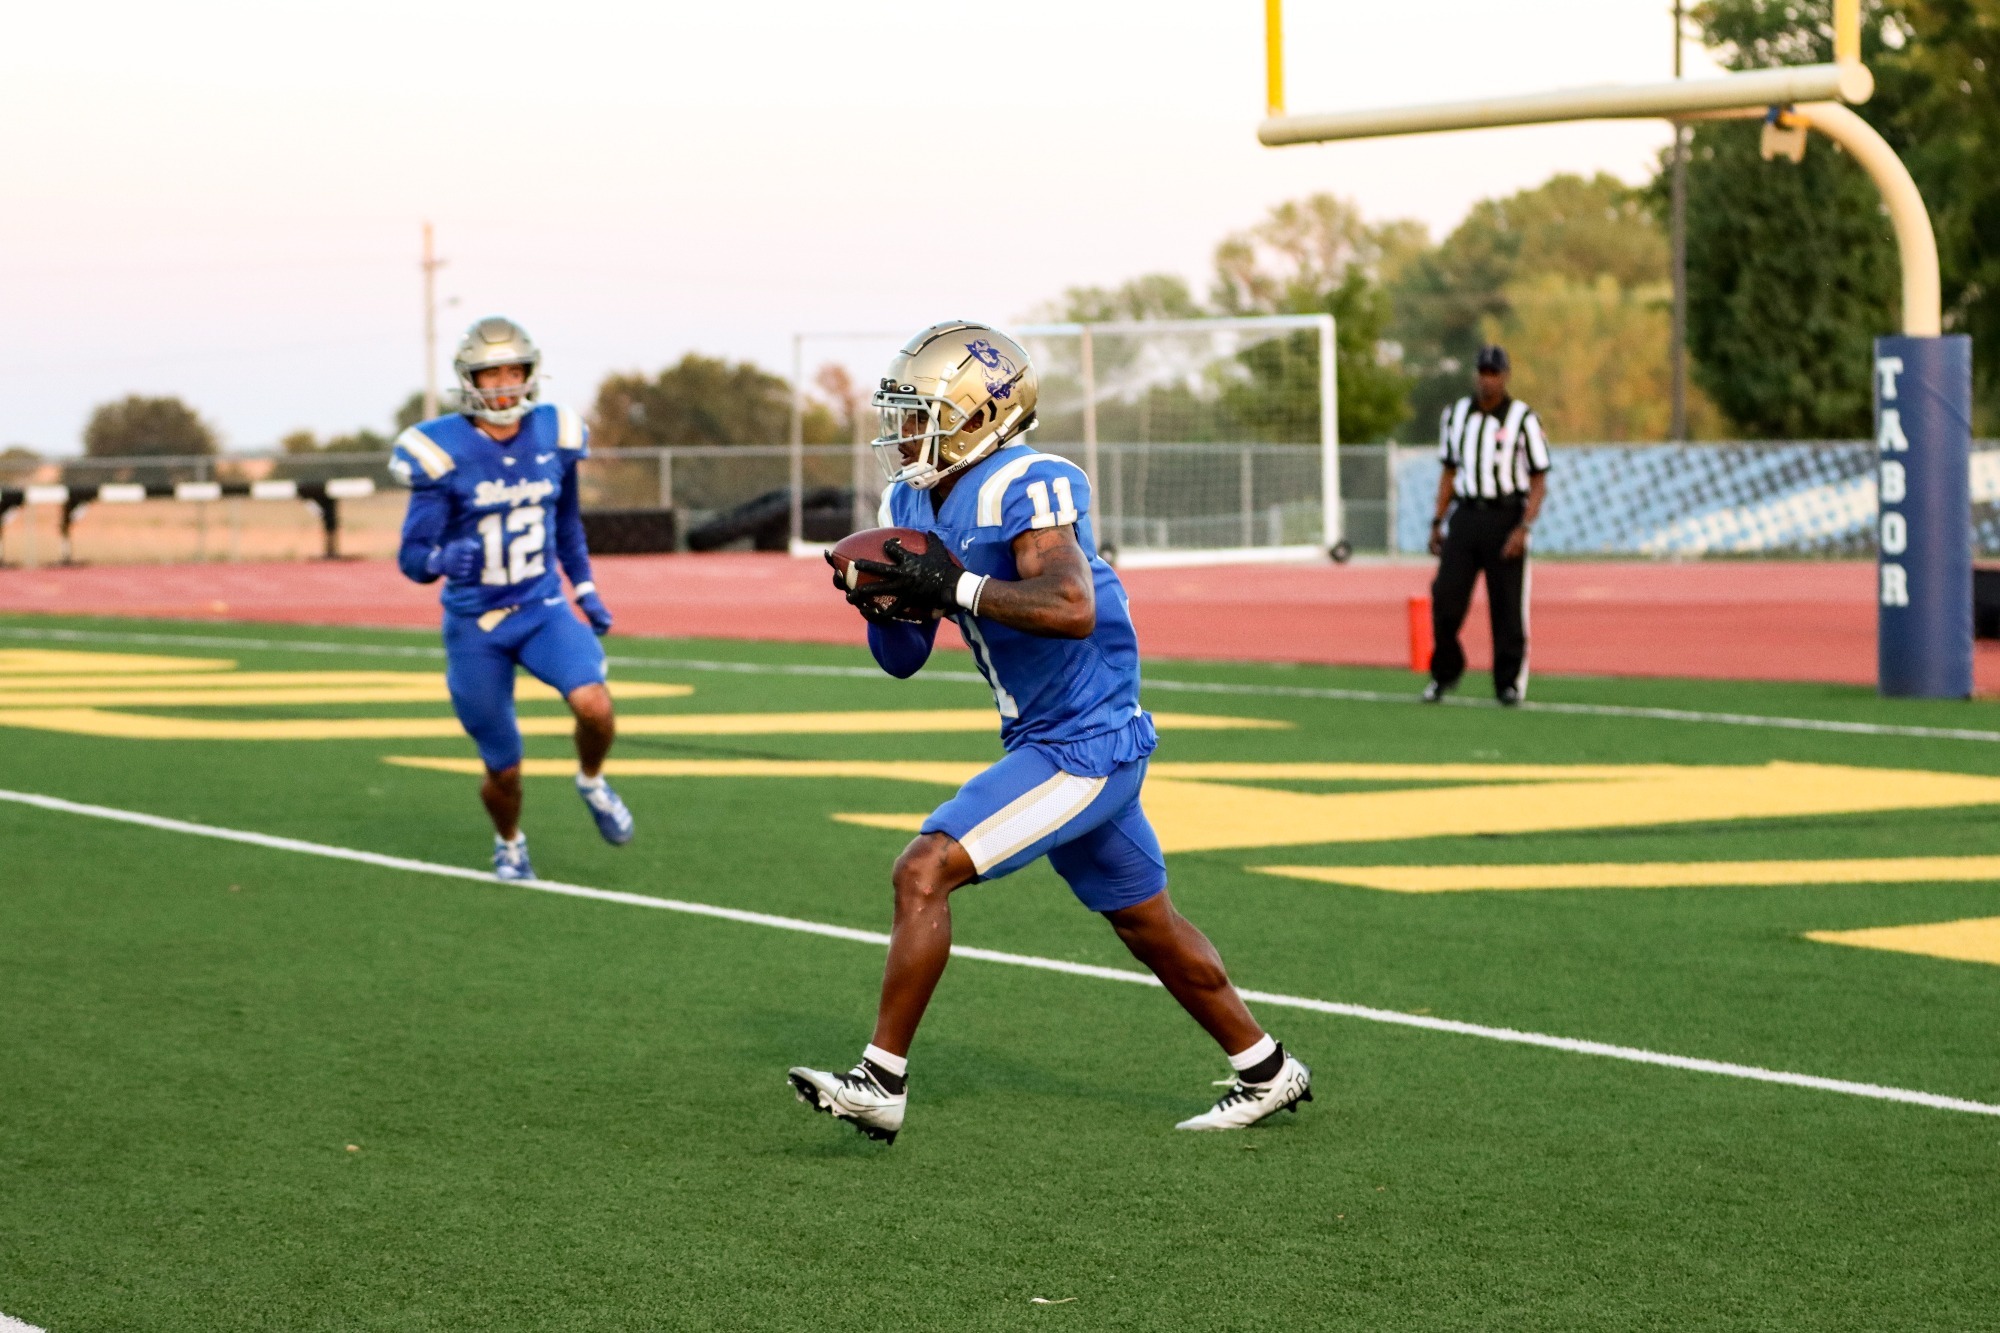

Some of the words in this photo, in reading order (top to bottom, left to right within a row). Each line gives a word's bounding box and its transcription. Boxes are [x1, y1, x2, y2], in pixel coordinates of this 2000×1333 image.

[1026, 477, 1078, 529] 11
[1877, 357, 1909, 606] TABOR
[478, 505, 546, 585] 12
